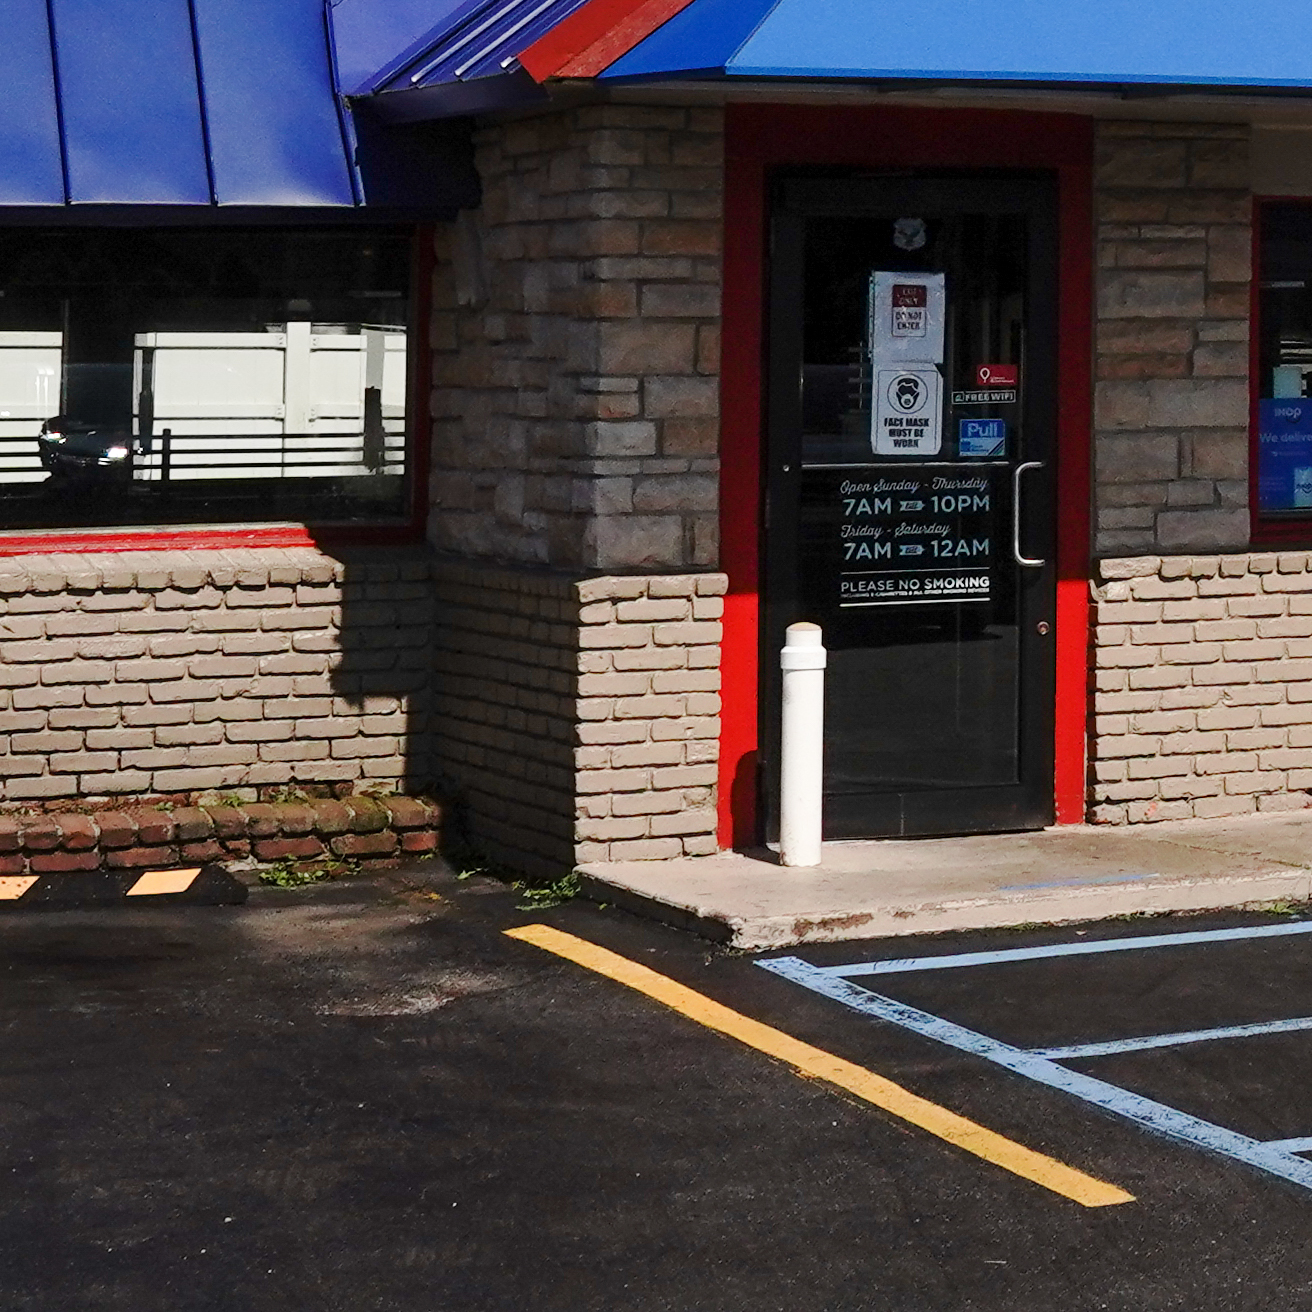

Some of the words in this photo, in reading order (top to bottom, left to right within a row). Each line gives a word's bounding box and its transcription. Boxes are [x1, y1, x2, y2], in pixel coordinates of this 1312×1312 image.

[884, 417, 904, 427] FACE
[905, 417, 930, 427] MASK
[967, 422, 998, 437] Pull
[888, 428, 912, 438] MUST
[1258, 432, 1279, 443] We
[893, 438, 919, 448] WORN
[840, 479, 872, 495] Open
[872, 478, 922, 494] Sunday
[931, 476, 989, 492] Thursday
[842, 496, 892, 516] 7AM
[930, 494, 990, 513] 10PM
[840, 524, 885, 540] Friday
[894, 521, 951, 538] Saturday
[843, 541, 892, 561] 7AM
[930, 538, 990, 557] 12AM
[841, 579, 895, 592] PLEASE
[898, 579, 920, 590] NO
[923, 576, 990, 589] SMOKING
